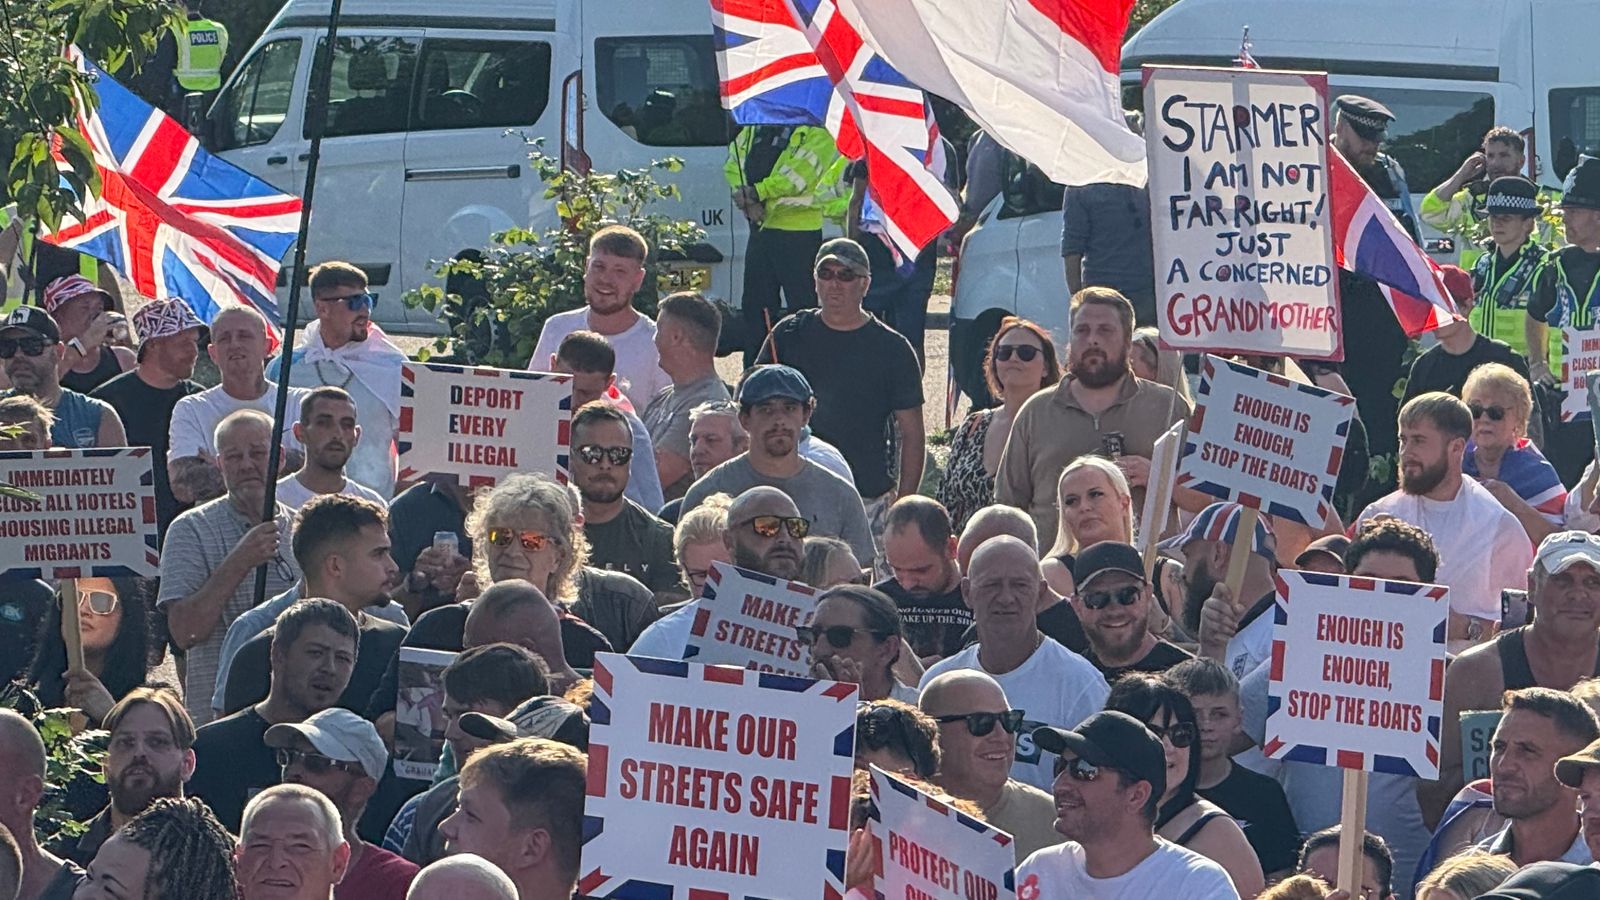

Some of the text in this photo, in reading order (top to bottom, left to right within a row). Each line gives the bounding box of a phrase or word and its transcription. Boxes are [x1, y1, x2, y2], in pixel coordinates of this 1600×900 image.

[191, 31, 218, 44] POLICE
[1161, 94, 1324, 154] STARMER
[1183, 155, 1322, 193] I AM NOT
[702, 208, 724, 227] UK
[1169, 193, 1327, 231] FAR RIGHT!
[1215, 231, 1292, 258] JUST
[1166, 257, 1332, 287] A CONCERNED
[1166, 292, 1338, 338] GRANDMOTHER
[1572, 355, 1598, 372] CLOSE
[450, 384, 525, 411] DEPORT
[1232, 392, 1312, 434] ENOUGH IS
[449, 413, 507, 438] EVERY
[1233, 422, 1295, 461] ENOUGH,
[447, 441, 519, 468] ILLEGAL
[1200, 441, 1320, 495] STOP THE BOATS
[8, 467, 116, 487] IMMEDIATELY
[45, 493, 73, 512] ALL
[76, 492, 137, 511] HOTELS
[74, 517, 137, 536] ILLEGAL
[24, 542, 112, 562] MIGRANTS
[740, 593, 801, 629] MAKE
[922, 615, 935, 624] UP
[714, 620, 801, 662] STREETS
[1316, 613, 1404, 650] ENOUGH IS
[1322, 654, 1393, 692] ENOUGH,
[1287, 689, 1422, 733] STOP THE BOATS
[647, 702, 798, 761] MAKE OUR
[619, 758, 820, 825] STREETS SAFE
[667, 825, 760, 877] AGAIN
[888, 830, 960, 896] PROTECT
